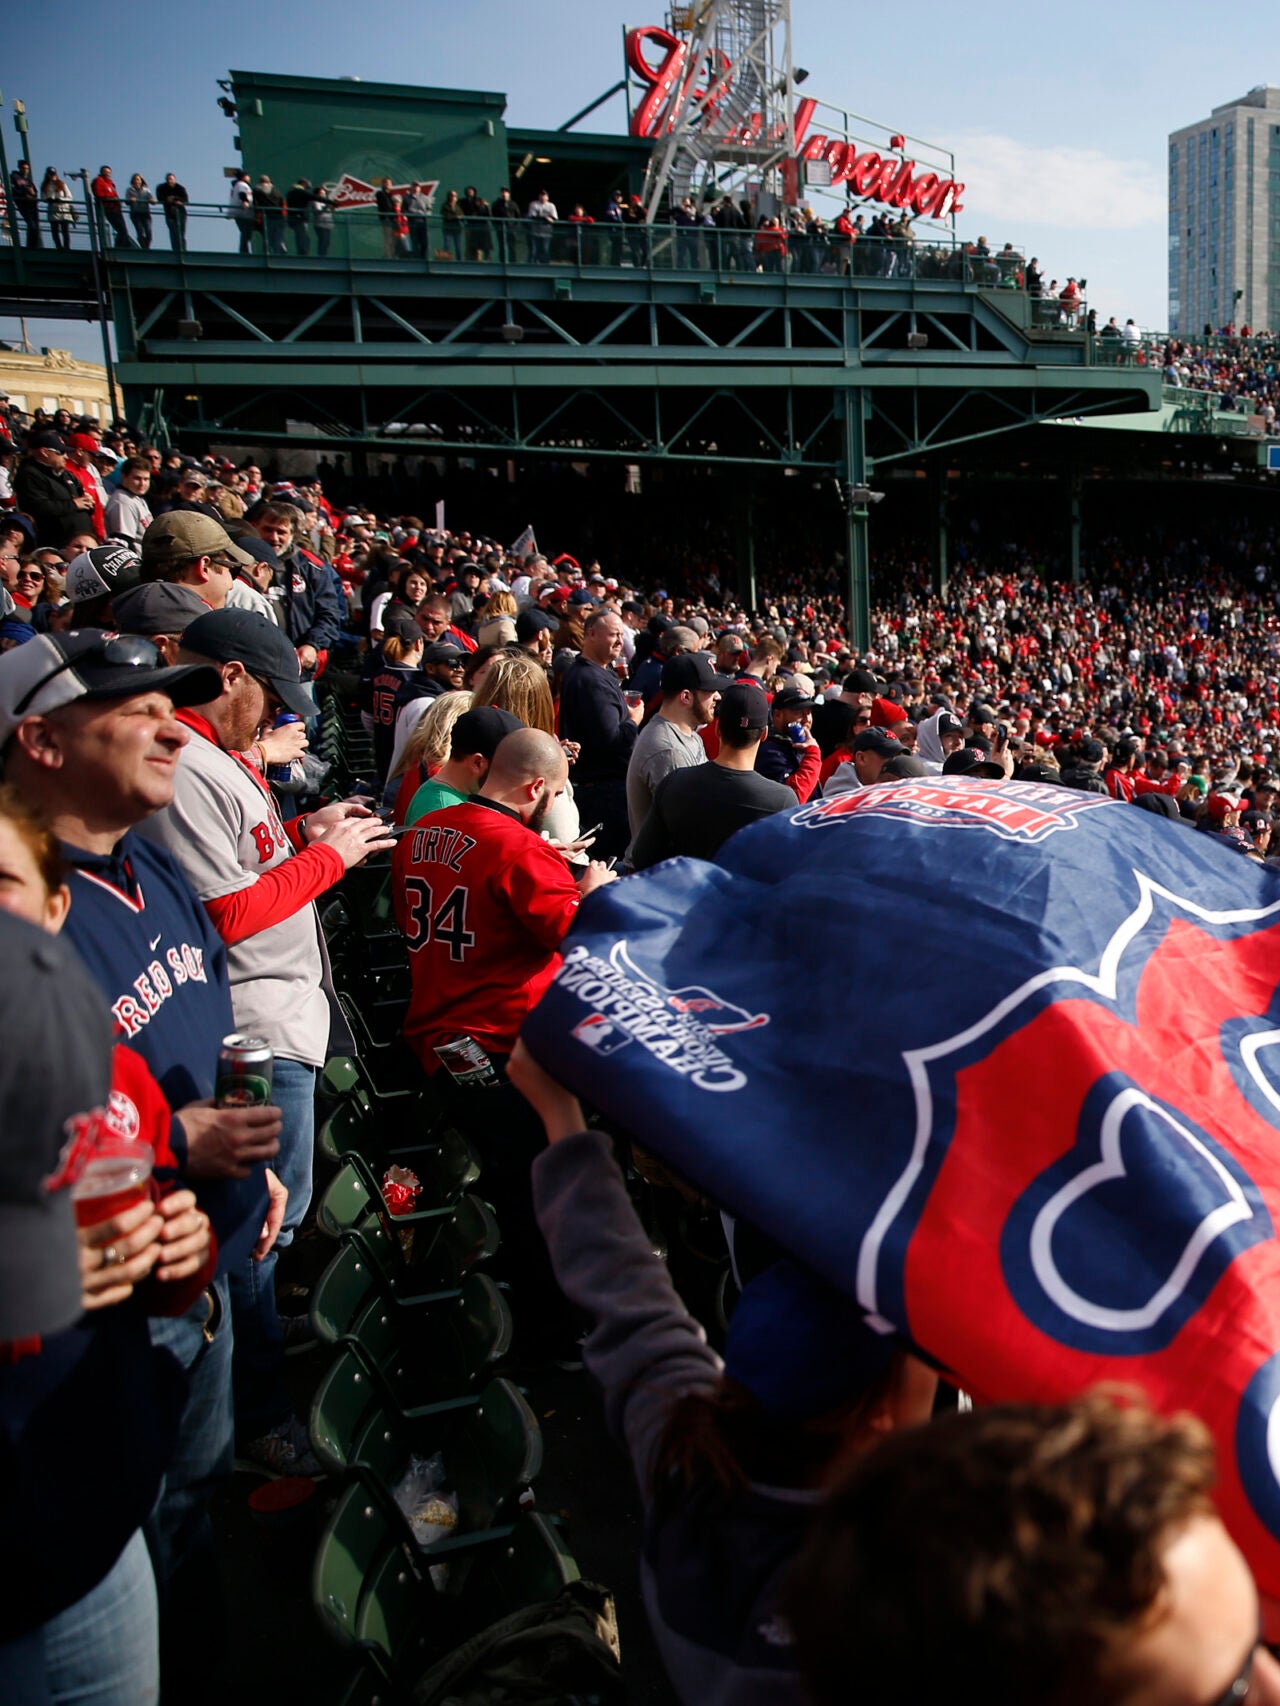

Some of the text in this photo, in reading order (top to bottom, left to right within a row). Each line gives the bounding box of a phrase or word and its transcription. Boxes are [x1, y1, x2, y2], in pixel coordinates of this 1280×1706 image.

[372, 690, 395, 726] 15
[411, 826, 477, 873] ORTIZ
[405, 874, 475, 962] 34
[111, 943, 208, 1039] RED SOX
